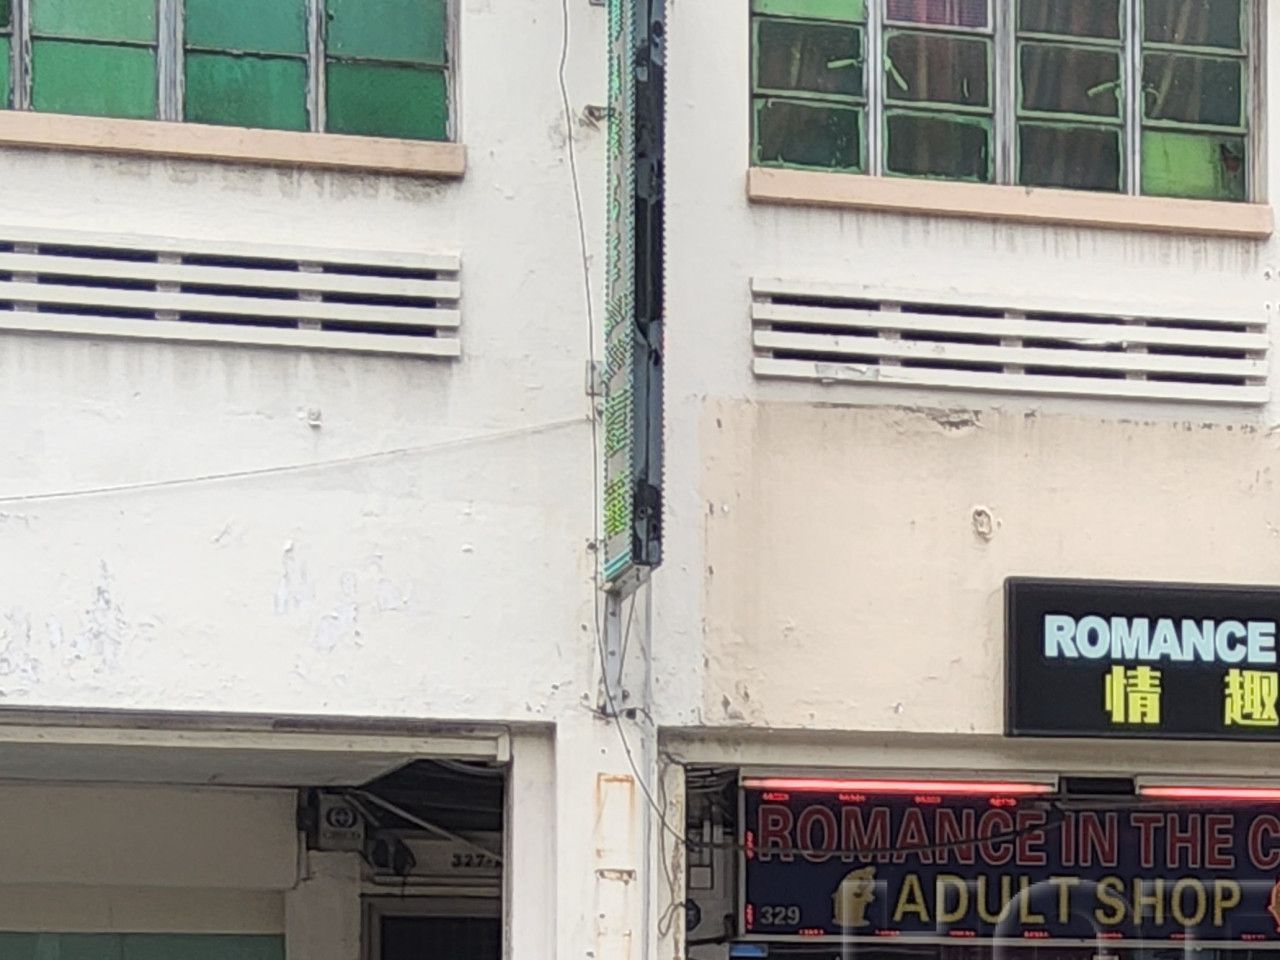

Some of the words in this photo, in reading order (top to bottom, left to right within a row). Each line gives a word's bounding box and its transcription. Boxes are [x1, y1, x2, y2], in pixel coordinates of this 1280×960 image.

[1044, 614, 1277, 663] ROMANCE
[758, 804, 1047, 866] ROMANCE
[1060, 812, 1118, 868] IN
[1131, 811, 1234, 869] THE
[760, 905, 800, 926] 329
[893, 873, 1081, 925] ADULT
[1094, 875, 1242, 927] SHOP
